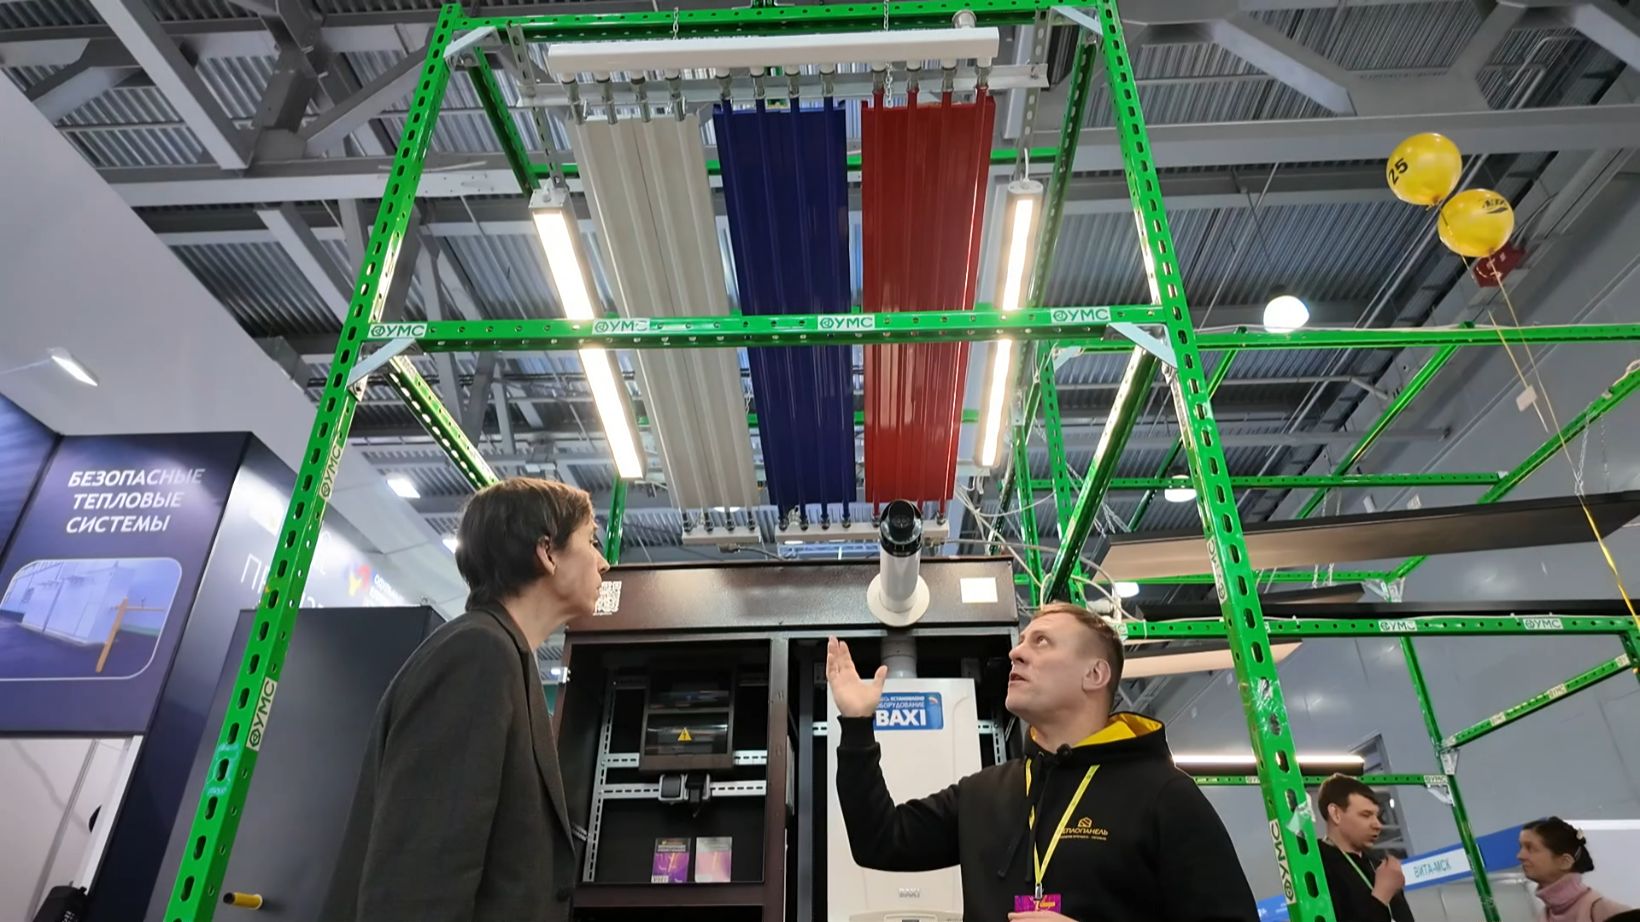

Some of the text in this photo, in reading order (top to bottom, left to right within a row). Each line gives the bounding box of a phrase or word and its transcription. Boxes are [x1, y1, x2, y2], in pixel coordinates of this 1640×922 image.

[1389, 159, 1408, 184] 25
[834, 317, 873, 328] УМС
[1068, 309, 1109, 321] УМС
[387, 325, 425, 336] УМС
[323, 445, 341, 484] УМС
[68, 468, 205, 487] БЕЗОПАСНЫЕ
[73, 492, 184, 510] ТЕПЛОВЫЕ
[66, 515, 171, 533] СИСТЕМЫ
[253, 680, 276, 728] УМС
[875, 709, 927, 726] BAXI
[1062, 828, 1109, 836] ЕПЛОПАНЕЛЬ
[1270, 821, 1290, 880] УМС
